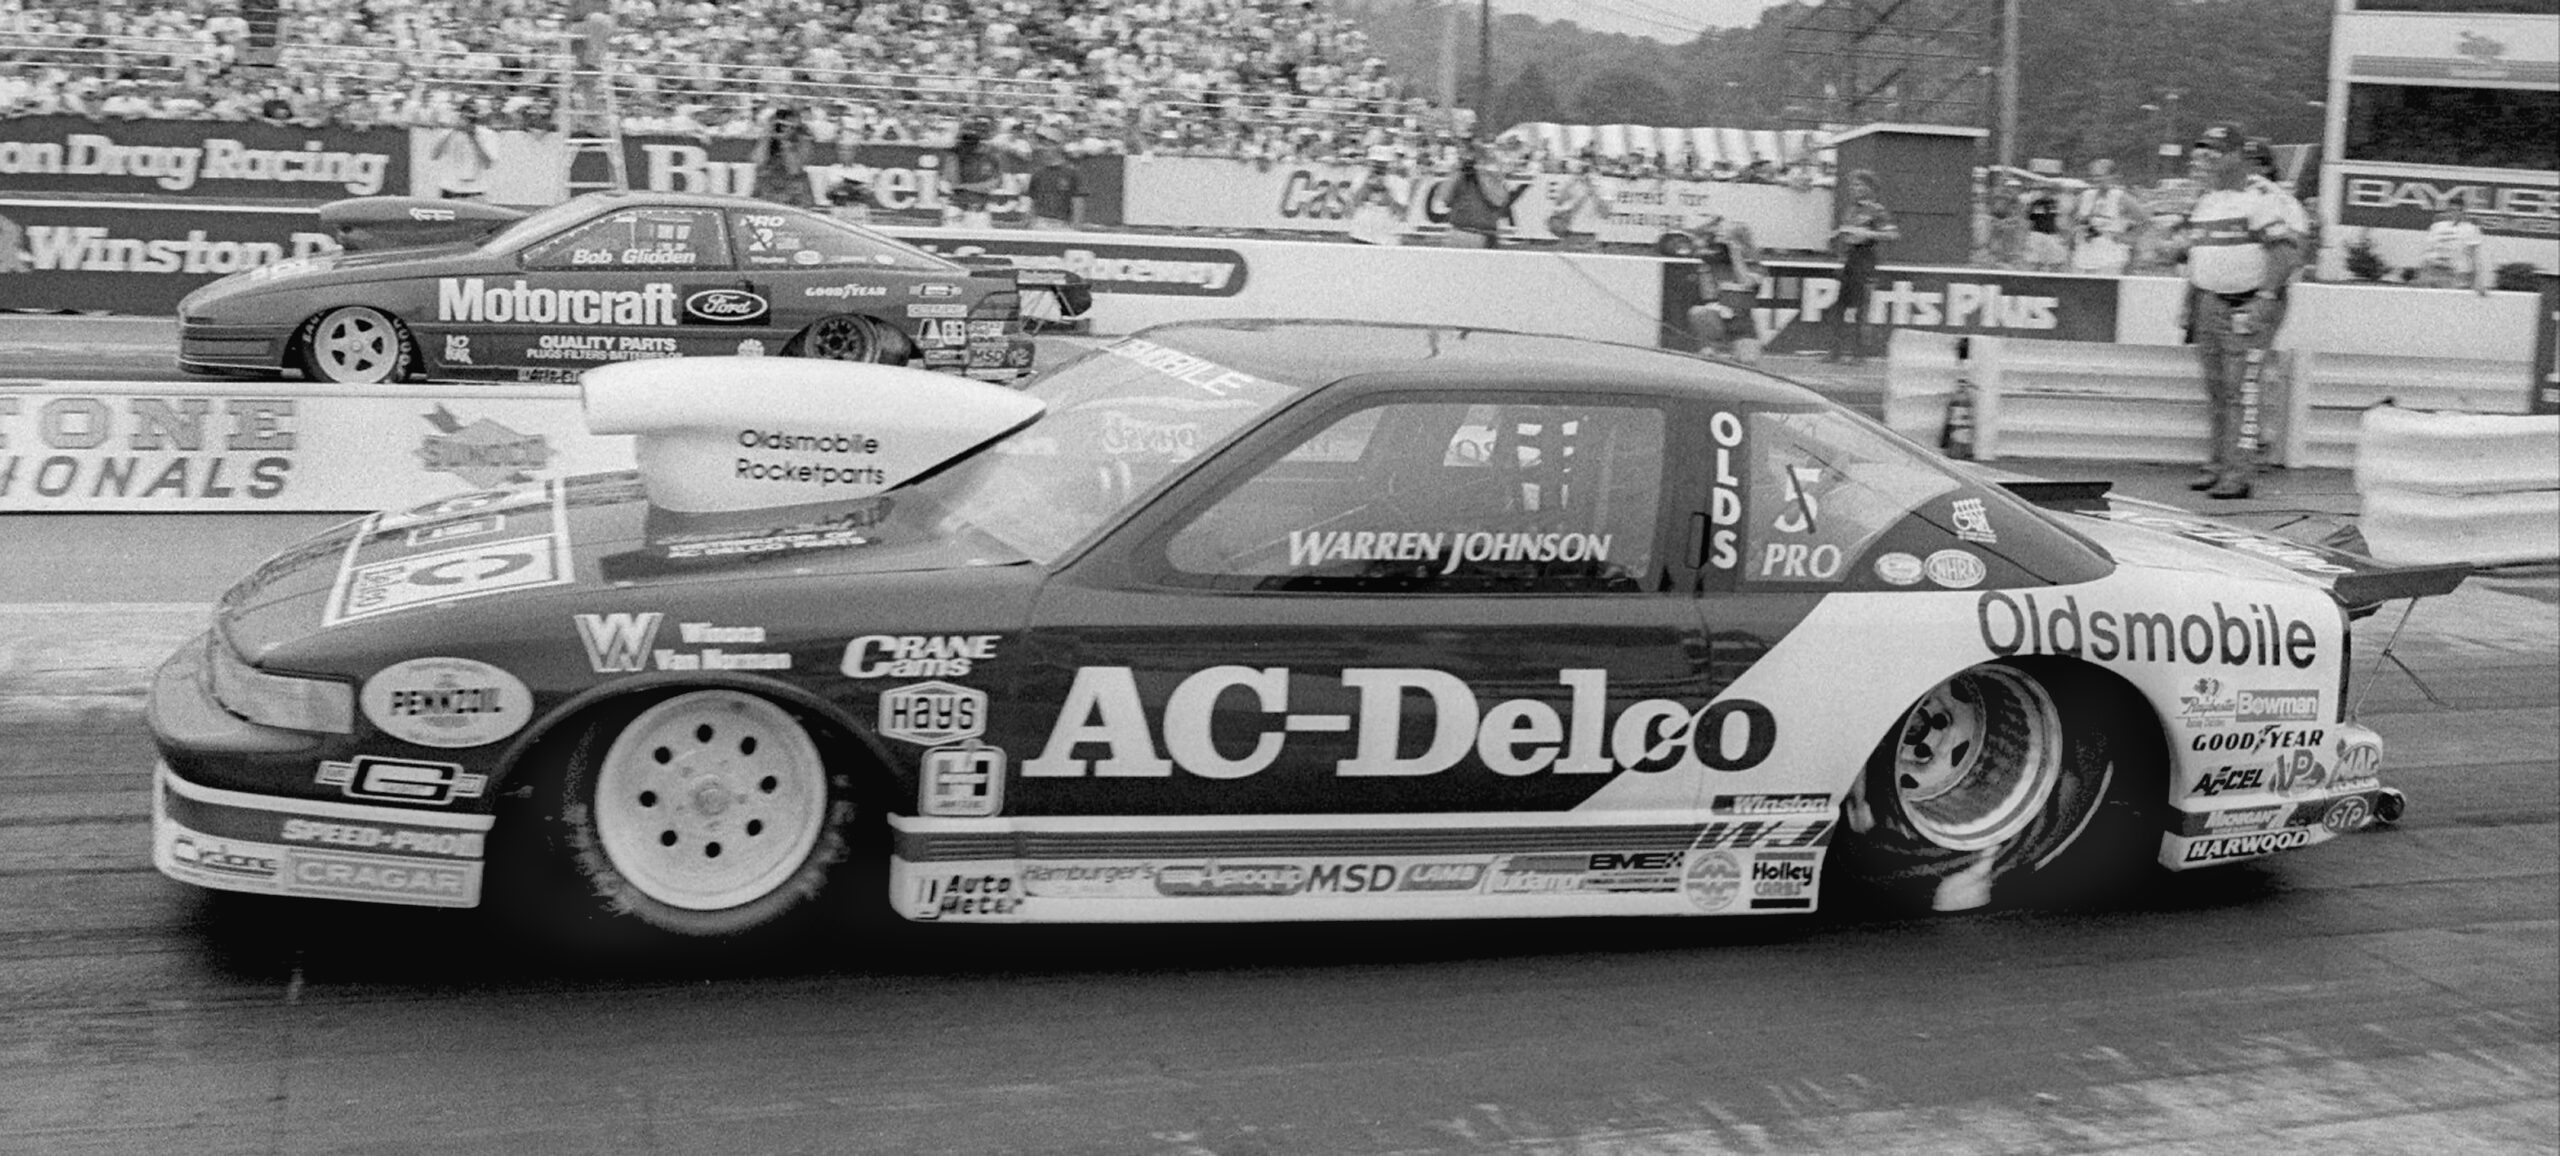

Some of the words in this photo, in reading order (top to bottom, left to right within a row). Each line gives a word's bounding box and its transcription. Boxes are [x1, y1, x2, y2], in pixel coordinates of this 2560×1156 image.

[67, 134, 200, 190] Drag
[202, 139, 390, 195] Racing
[27, 225, 283, 274] Winston
[572, 248, 612, 265] Bob
[622, 249, 696, 265] Glidden
[438, 277, 678, 327] Motorcraft
[702, 292, 753, 315] Ford
[1801, 276, 1943, 327] Prts
[1946, 283, 2059, 329] Plus
[539, 335, 616, 350] QUALITY
[619, 336, 678, 351] PARTS
[740, 429, 879, 455] Oldsmobile
[736, 459, 885, 487] Rocketparts
[1710, 412, 1742, 569] OLDS
[1775, 466, 1821, 532] 5
[1288, 531, 1444, 565] WARREN
[1441, 533, 1612, 575] JOHNSON
[1760, 544, 1843, 579] PRO
[1978, 590, 2317, 669] Oldsmobile
[893, 697, 975, 729] Hays
[2239, 692, 2318, 715] Bowman
[1021, 664, 1777, 778] AC-Delco
[2192, 724, 2325, 755] GOODYEAR
[1733, 794, 1828, 814] Winston
[2328, 801, 2363, 829] STP
[2190, 830, 2310, 859] HARWOOD
[300, 860, 466, 892] CRAGAR
[1589, 853, 1668, 870] BME
[1752, 862, 1813, 886] Holley
[945, 875, 1011, 893] Auto
[1305, 864, 1397, 893] MSD
[941, 896, 1024, 915] Meter
